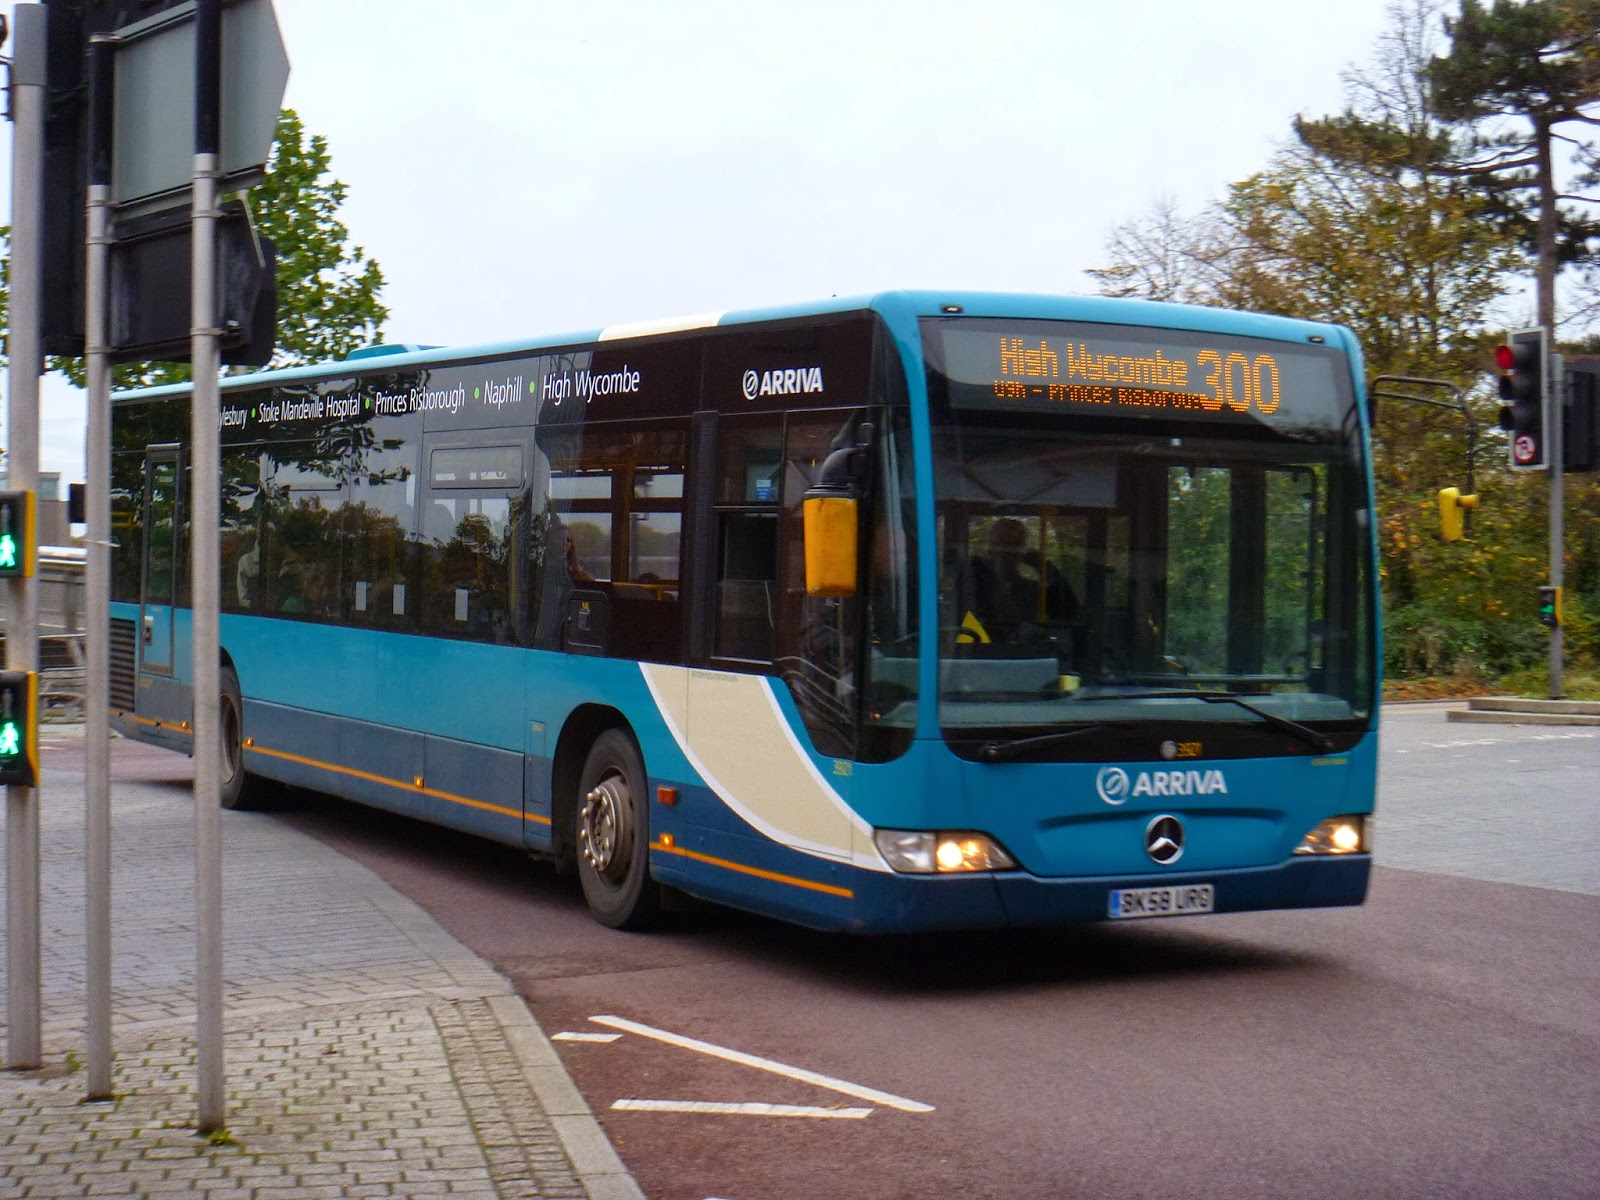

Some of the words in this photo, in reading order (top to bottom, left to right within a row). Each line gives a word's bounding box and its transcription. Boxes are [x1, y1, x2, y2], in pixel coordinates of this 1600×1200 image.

[759, 367, 824, 396] ARRIVA
[1000, 337, 1058, 377] High
[1067, 342, 1188, 386] Wycombe
[1197, 349, 1281, 414] 300
[219, 404, 248, 431] ylesbury
[258, 400, 280, 423] Stoke
[281, 396, 324, 421] Mandeville
[326, 392, 361, 422] Hospital
[375, 389, 408, 414] Princes
[409, 382, 466, 414] Risborough
[484, 375, 523, 410] Naphill
[542, 371, 571, 406] High
[575, 364, 640, 403] Wycombe
[1132, 770, 1228, 797] ARRIVA
